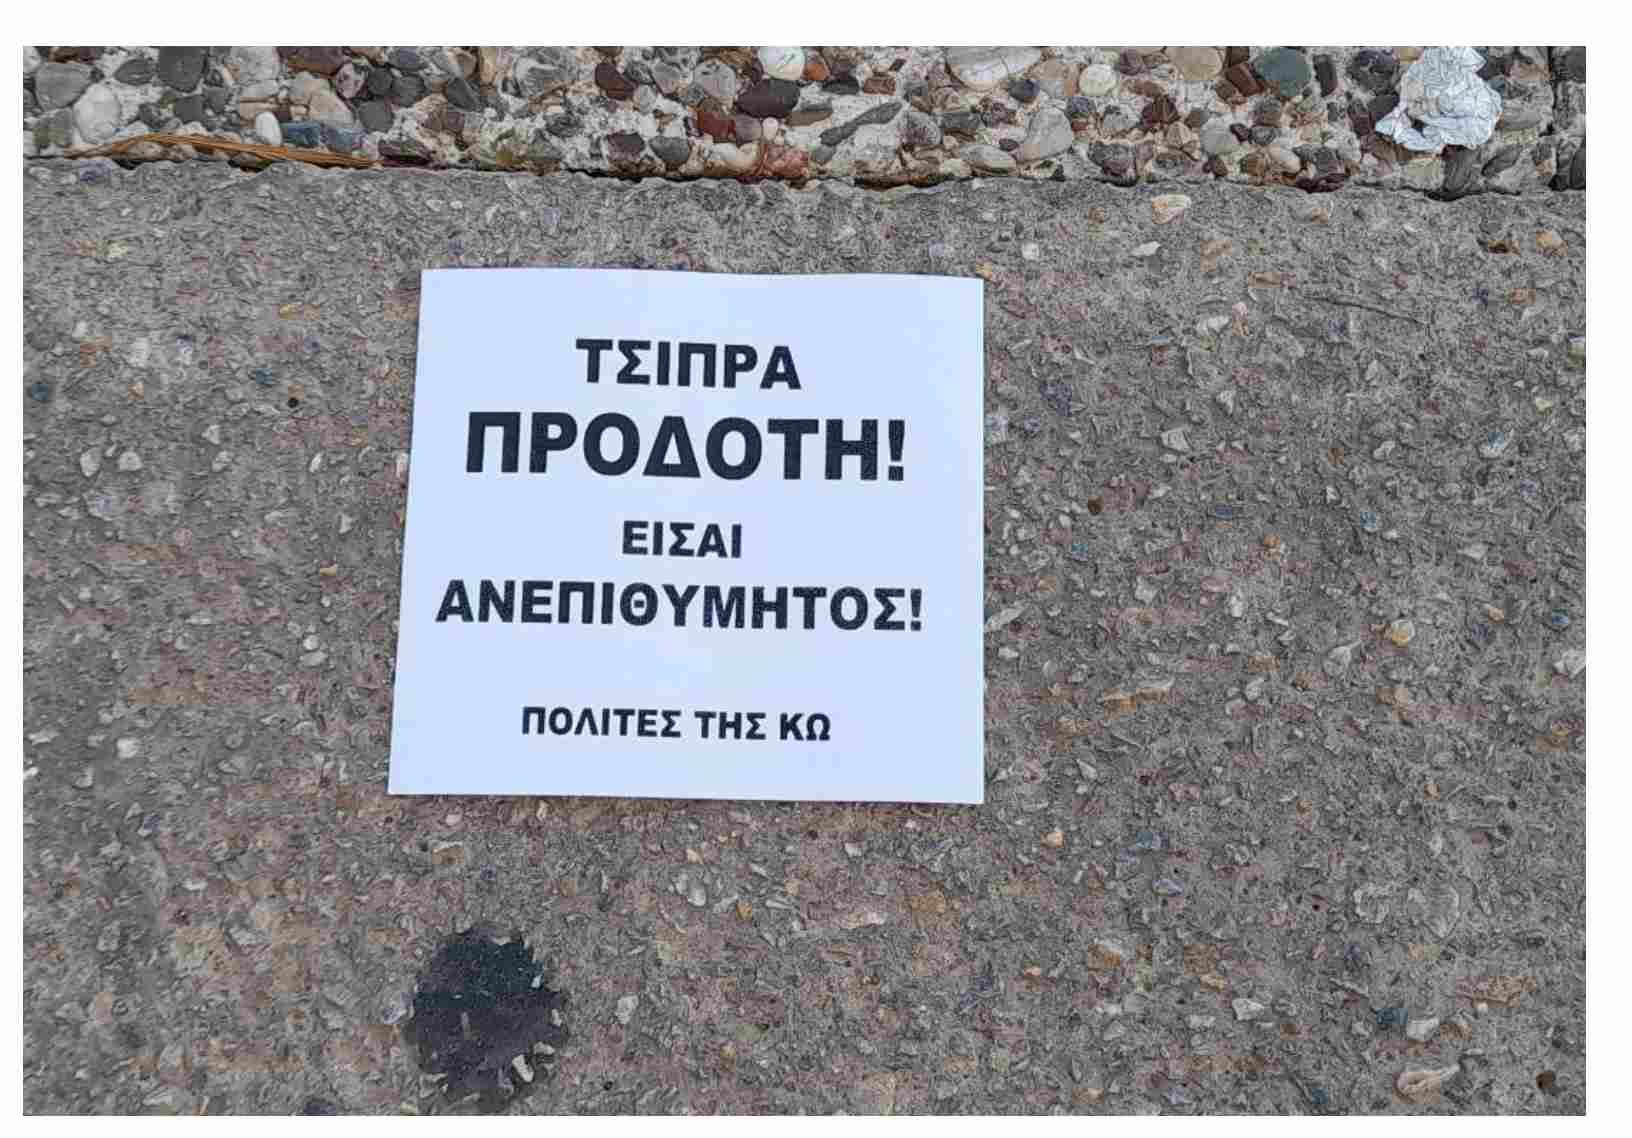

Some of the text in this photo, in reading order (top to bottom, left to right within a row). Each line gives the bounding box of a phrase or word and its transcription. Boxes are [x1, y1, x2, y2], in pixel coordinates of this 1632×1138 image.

[575, 338, 802, 390] ΤΣΙΠΡΑ
[466, 411, 906, 483] ΠΡΟΔΟΤΗ!
[622, 520, 743, 559] ΕΙΣΑΙ
[435, 579, 923, 632] ΑΝΕΠΙΘΥΜΗΤΟΣ!
[522, 706, 831, 742] ΠΟΛΙΤΕΣ ΤΗΣ ΚΩ
